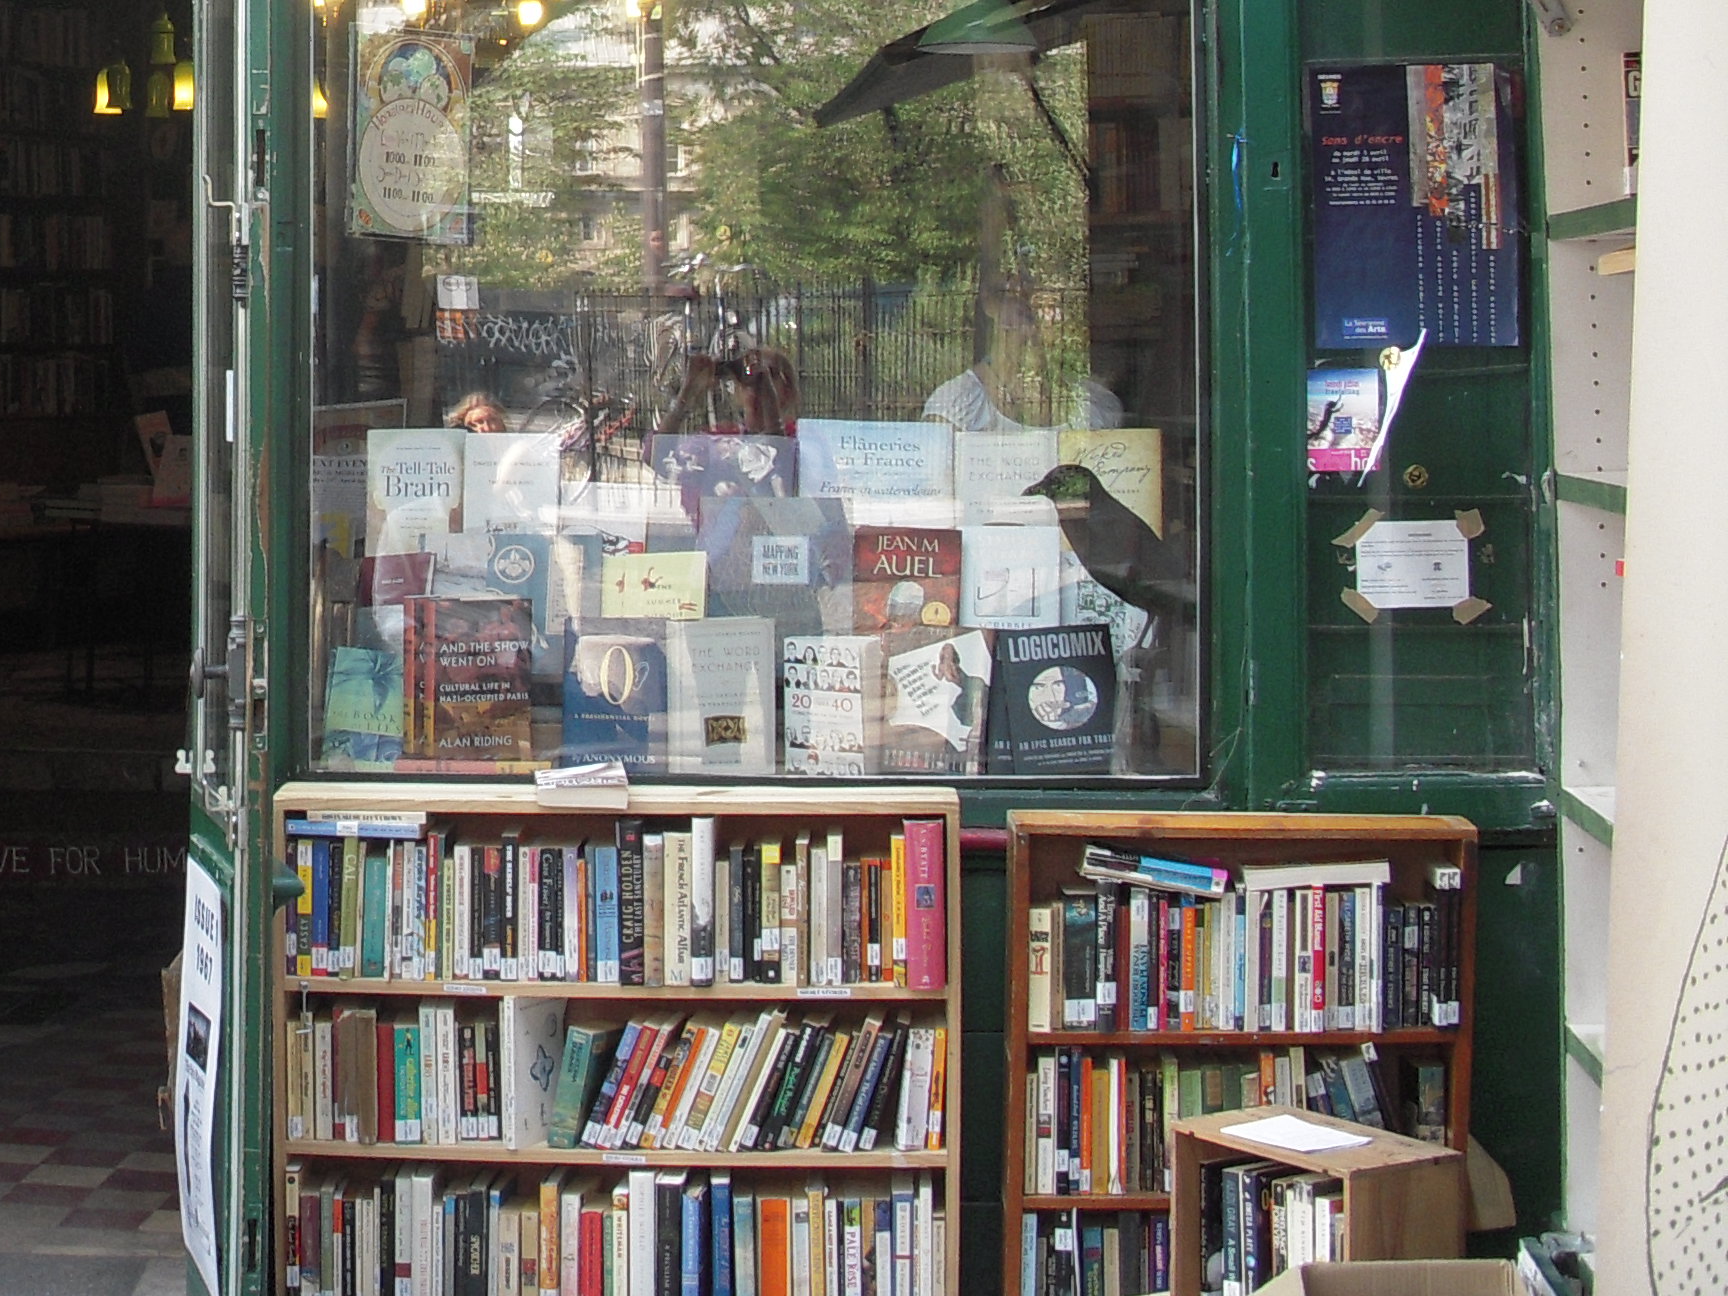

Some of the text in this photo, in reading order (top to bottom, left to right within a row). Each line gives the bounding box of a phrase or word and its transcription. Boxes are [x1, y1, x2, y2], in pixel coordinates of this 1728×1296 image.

[396, 462, 455, 475] Tell-Tale
[863, 452, 924, 467] France
[385, 475, 450, 497] Brain
[762, 544, 799, 559] MAPPING
[877, 535, 939, 553] JEAN M
[780, 563, 799, 576] YORK
[874, 555, 942, 577] AUEL
[440, 641, 529, 654] AND THE SHOW
[722, 647, 761, 655] WORD
[1008, 631, 1105, 663] LOGICOMIX
[439, 655, 496, 667] WENT ON
[439, 681, 511, 691] CULTURAL LIFE IN
[439, 691, 529, 703] NAZI-OCCUPIED PARIS
[791, 693, 812, 709] 20
[832, 697, 853, 713] 40
[439, 735, 512, 748] ALAN RIDING
[583, 753, 656, 764] ANONYMOUS
[49, 846, 100, 875] FOR
[124, 846, 186, 874] HUM
[344, 854, 357, 883] CAL
[621, 850, 633, 943] CRAIG HOLDEN
[1098, 894, 1106, 911] And
[194, 893, 214, 942] ISSUE
[1314, 889, 1323, 951] First Aid Manual
[298, 918, 309, 950] CASEY
[633, 924, 642, 938] THE
[1098, 921, 1106, 945] Place
[196, 943, 214, 985] 1967
[1226, 1207, 1236, 1233] GRAY
[846, 1231, 858, 1288] PALE ROSE
